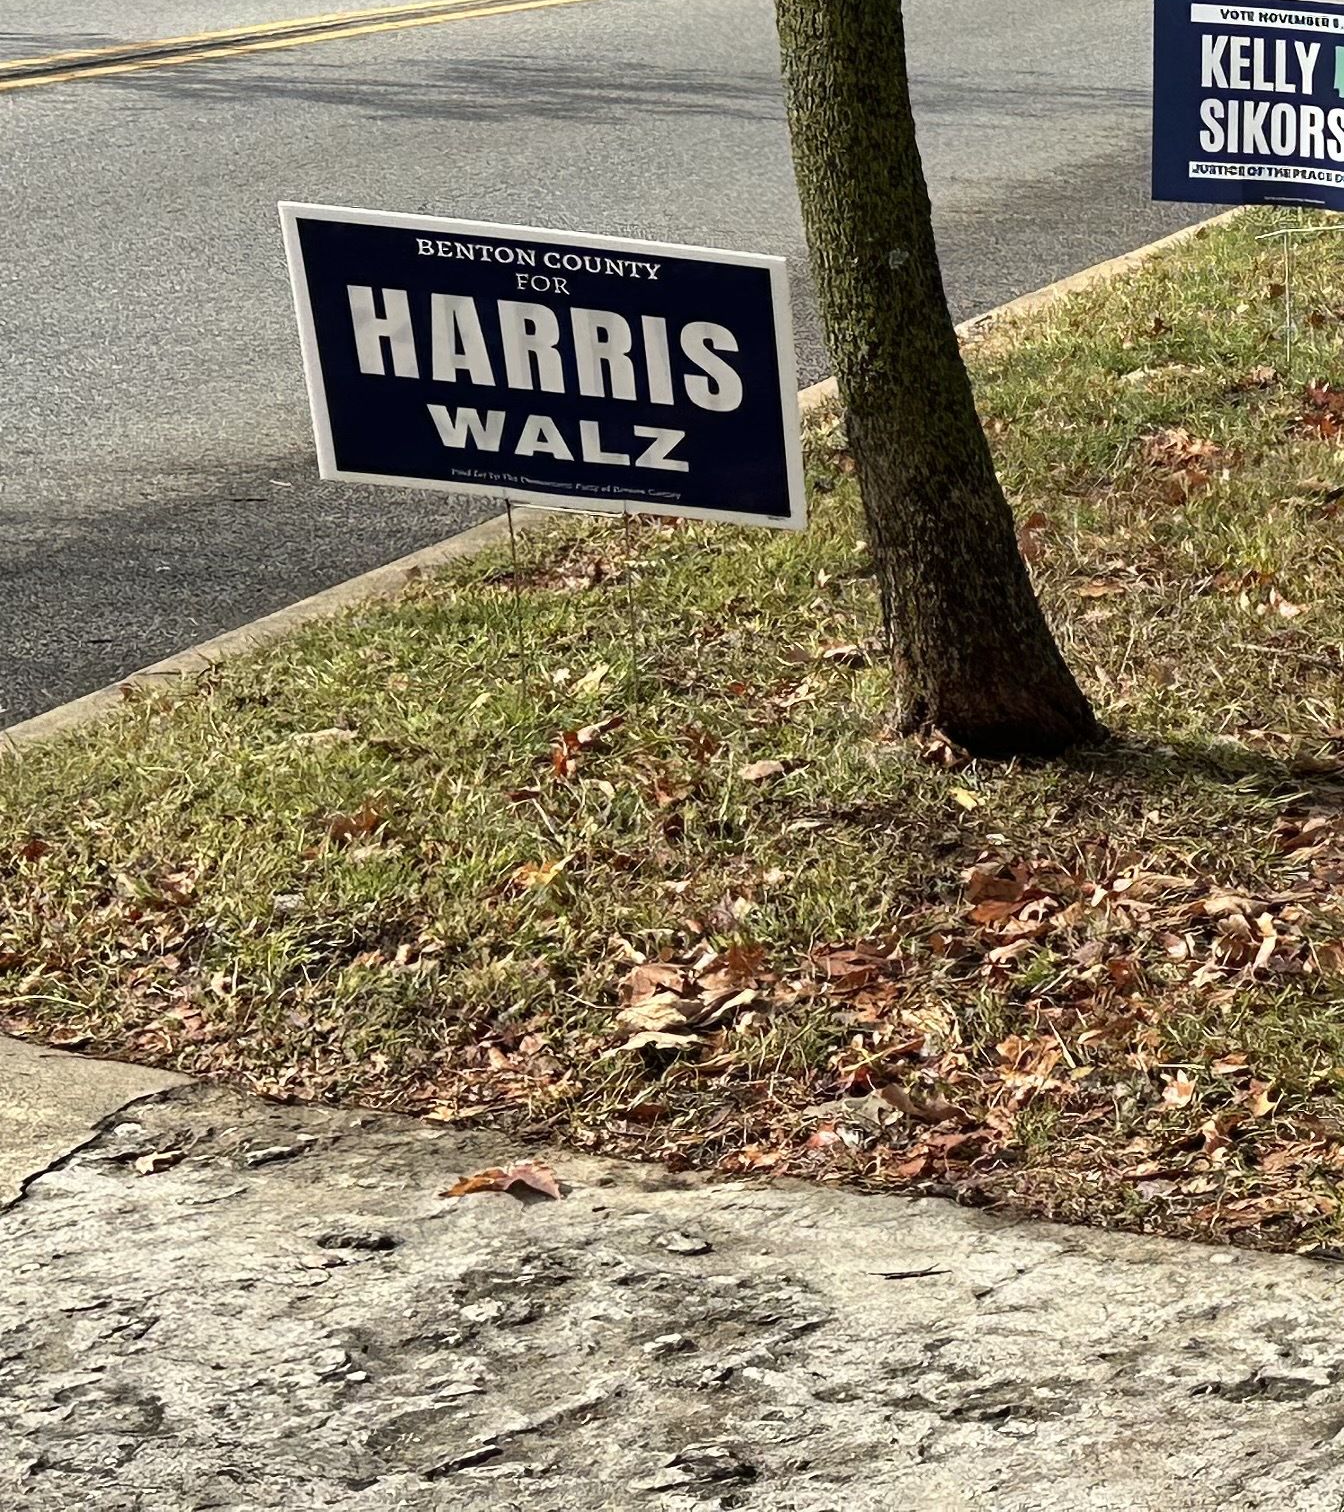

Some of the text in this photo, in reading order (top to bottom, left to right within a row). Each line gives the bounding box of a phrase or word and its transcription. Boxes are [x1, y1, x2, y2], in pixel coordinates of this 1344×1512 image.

[1220, 8, 1255, 22] VOTE
[1258, 12, 1329, 28] NOVEMBER
[1201, 34, 1321, 95] KELLY
[1191, 164, 1245, 176] JUSTICE
[1268, 167, 1291, 179] THE
[1293, 169, 1332, 182] PEACE
[417, 238, 662, 280] BENTON COUNTY
[515, 273, 570, 295] FOR
[347, 284, 744, 412] HARRIS
[427, 403, 690, 472] WALZ
